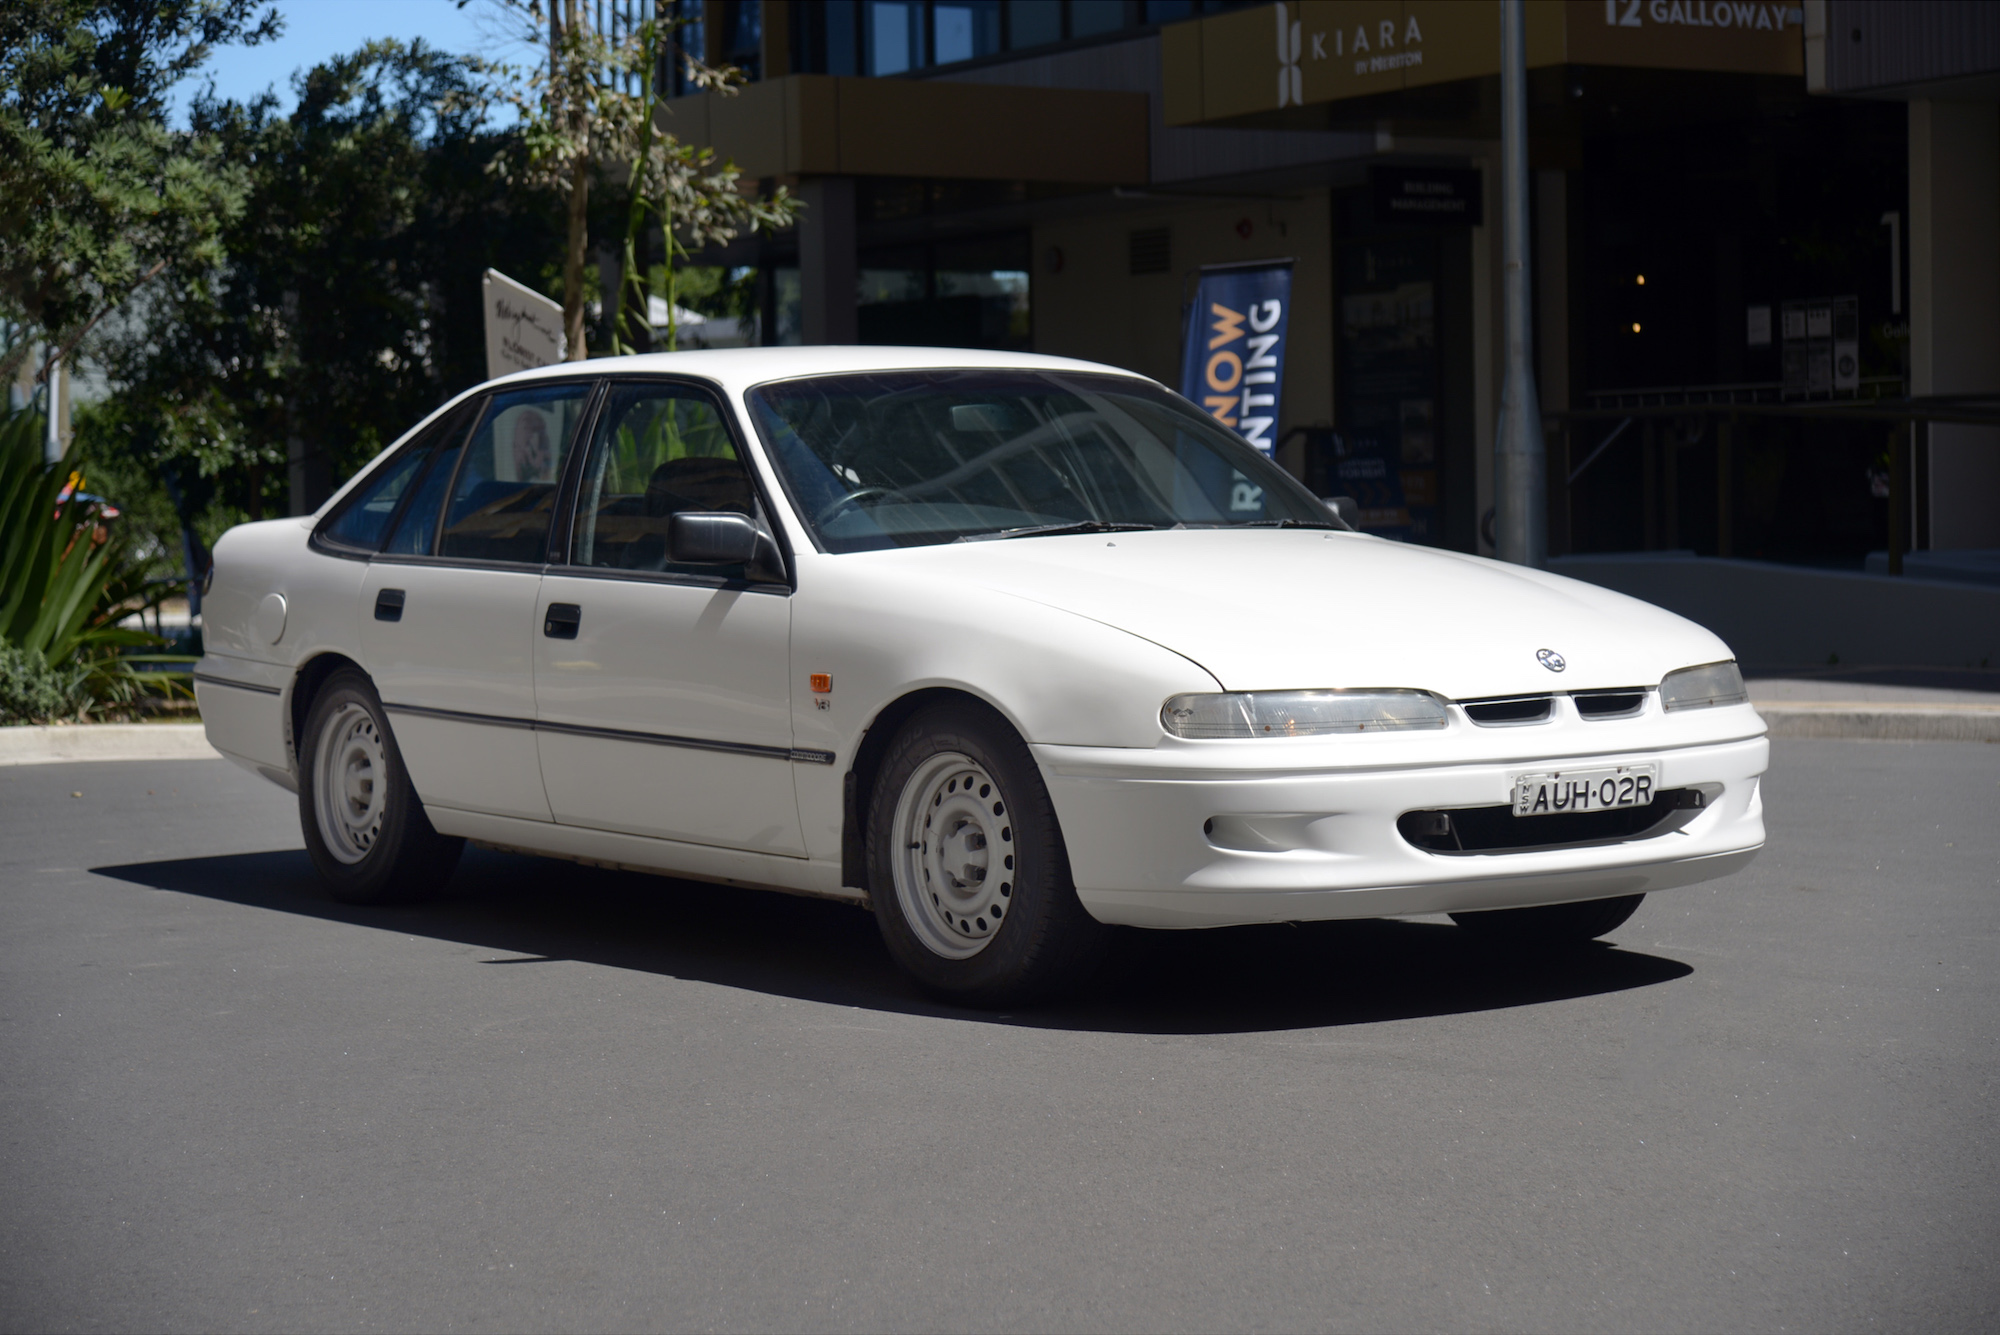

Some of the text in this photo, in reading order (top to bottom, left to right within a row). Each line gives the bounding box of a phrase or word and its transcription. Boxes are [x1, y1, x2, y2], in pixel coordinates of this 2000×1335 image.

[1605, 0, 1788, 31] 12 GALLOWAY
[1311, 14, 1423, 61] KIARA
[1355, 51, 1423, 76] BY MERITON
[1203, 302, 1247, 428] NOW
[1230, 298, 1282, 512] RNTING
[1519, 783, 1532, 815] NSW
